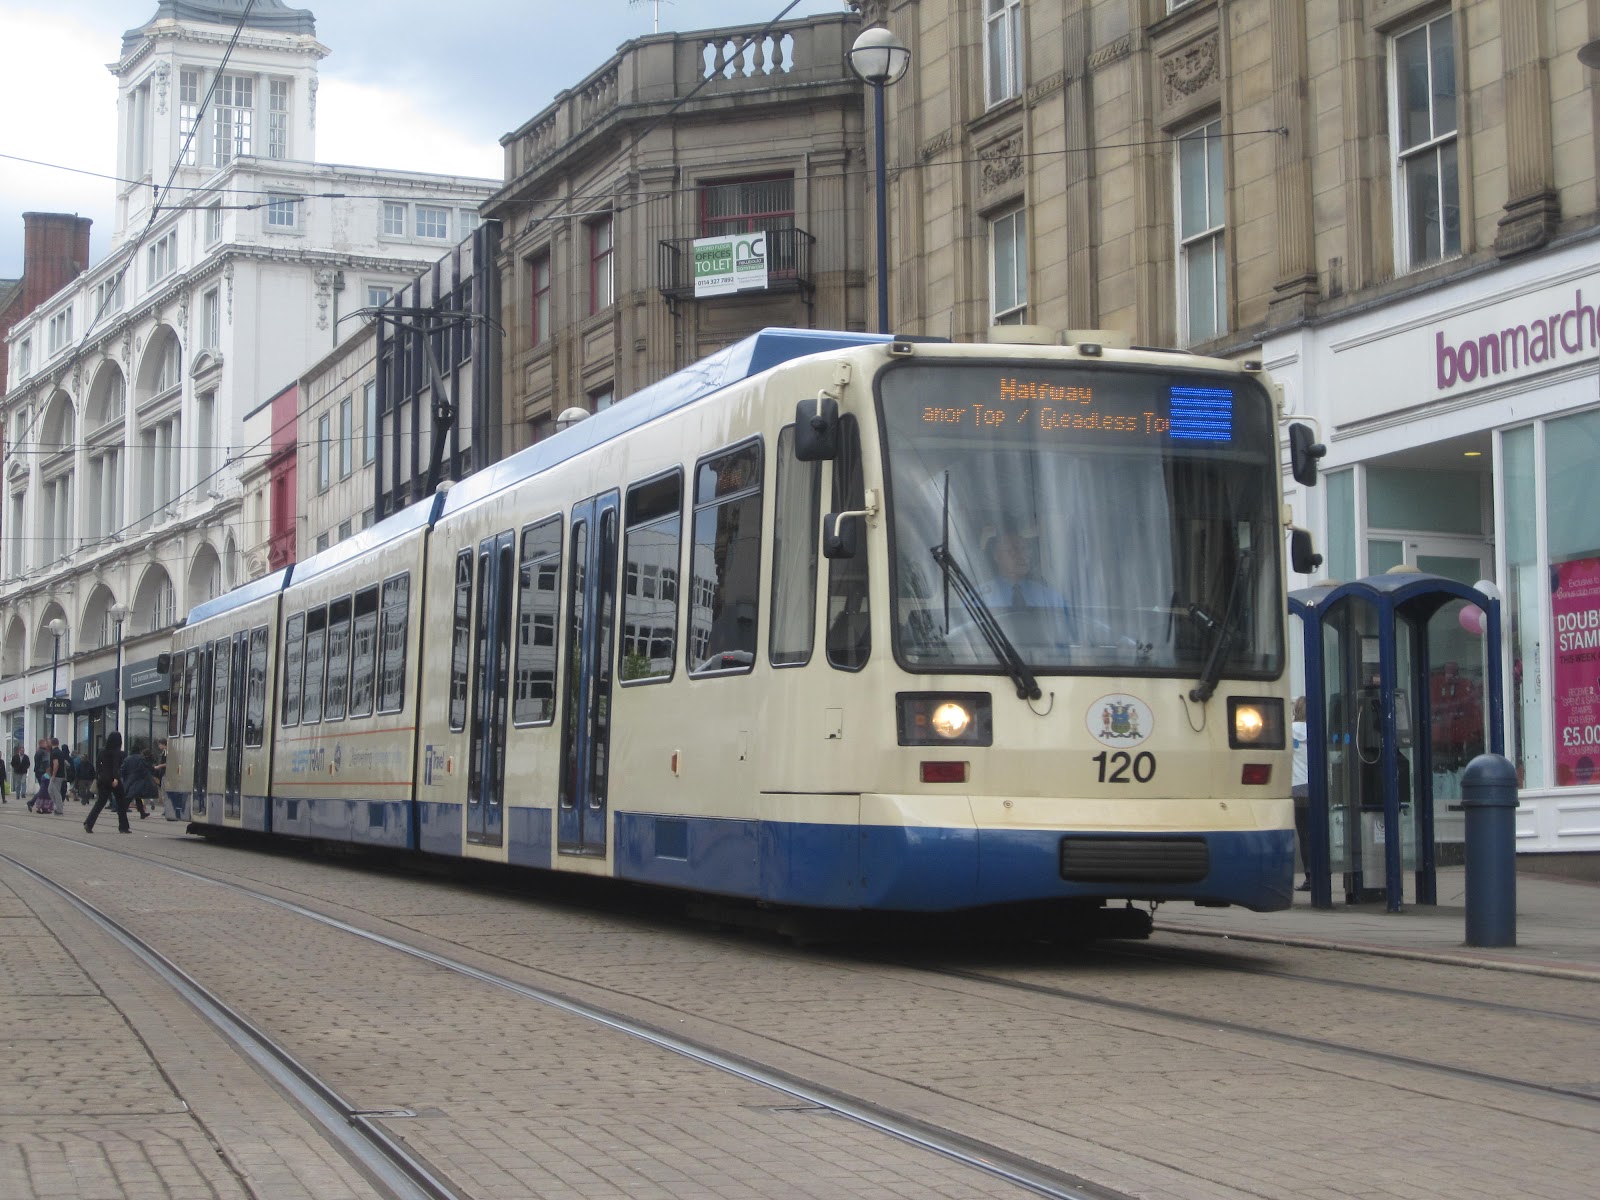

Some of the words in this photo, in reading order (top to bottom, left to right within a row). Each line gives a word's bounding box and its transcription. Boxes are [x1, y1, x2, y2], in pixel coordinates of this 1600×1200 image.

[696, 245, 714, 253] SECOND
[696, 250, 731, 261] OFFICES
[696, 261, 711, 273] TO
[714, 258, 732, 271] LET
[1436, 288, 1600, 390] bonmarch
[1001, 378, 1092, 405] Halfway
[972, 404, 1005, 427] Top
[1040, 407, 1137, 431] Gleadless
[1569, 578, 1593, 588] Exclusive
[1558, 609, 1600, 632] DOUB
[1560, 630, 1600, 652] STAM
[1590, 687, 1594, 695] 2
[1568, 716, 1579, 725] FOR
[1580, 714, 1596, 724] EVERY
[1092, 751, 1156, 783] 120
